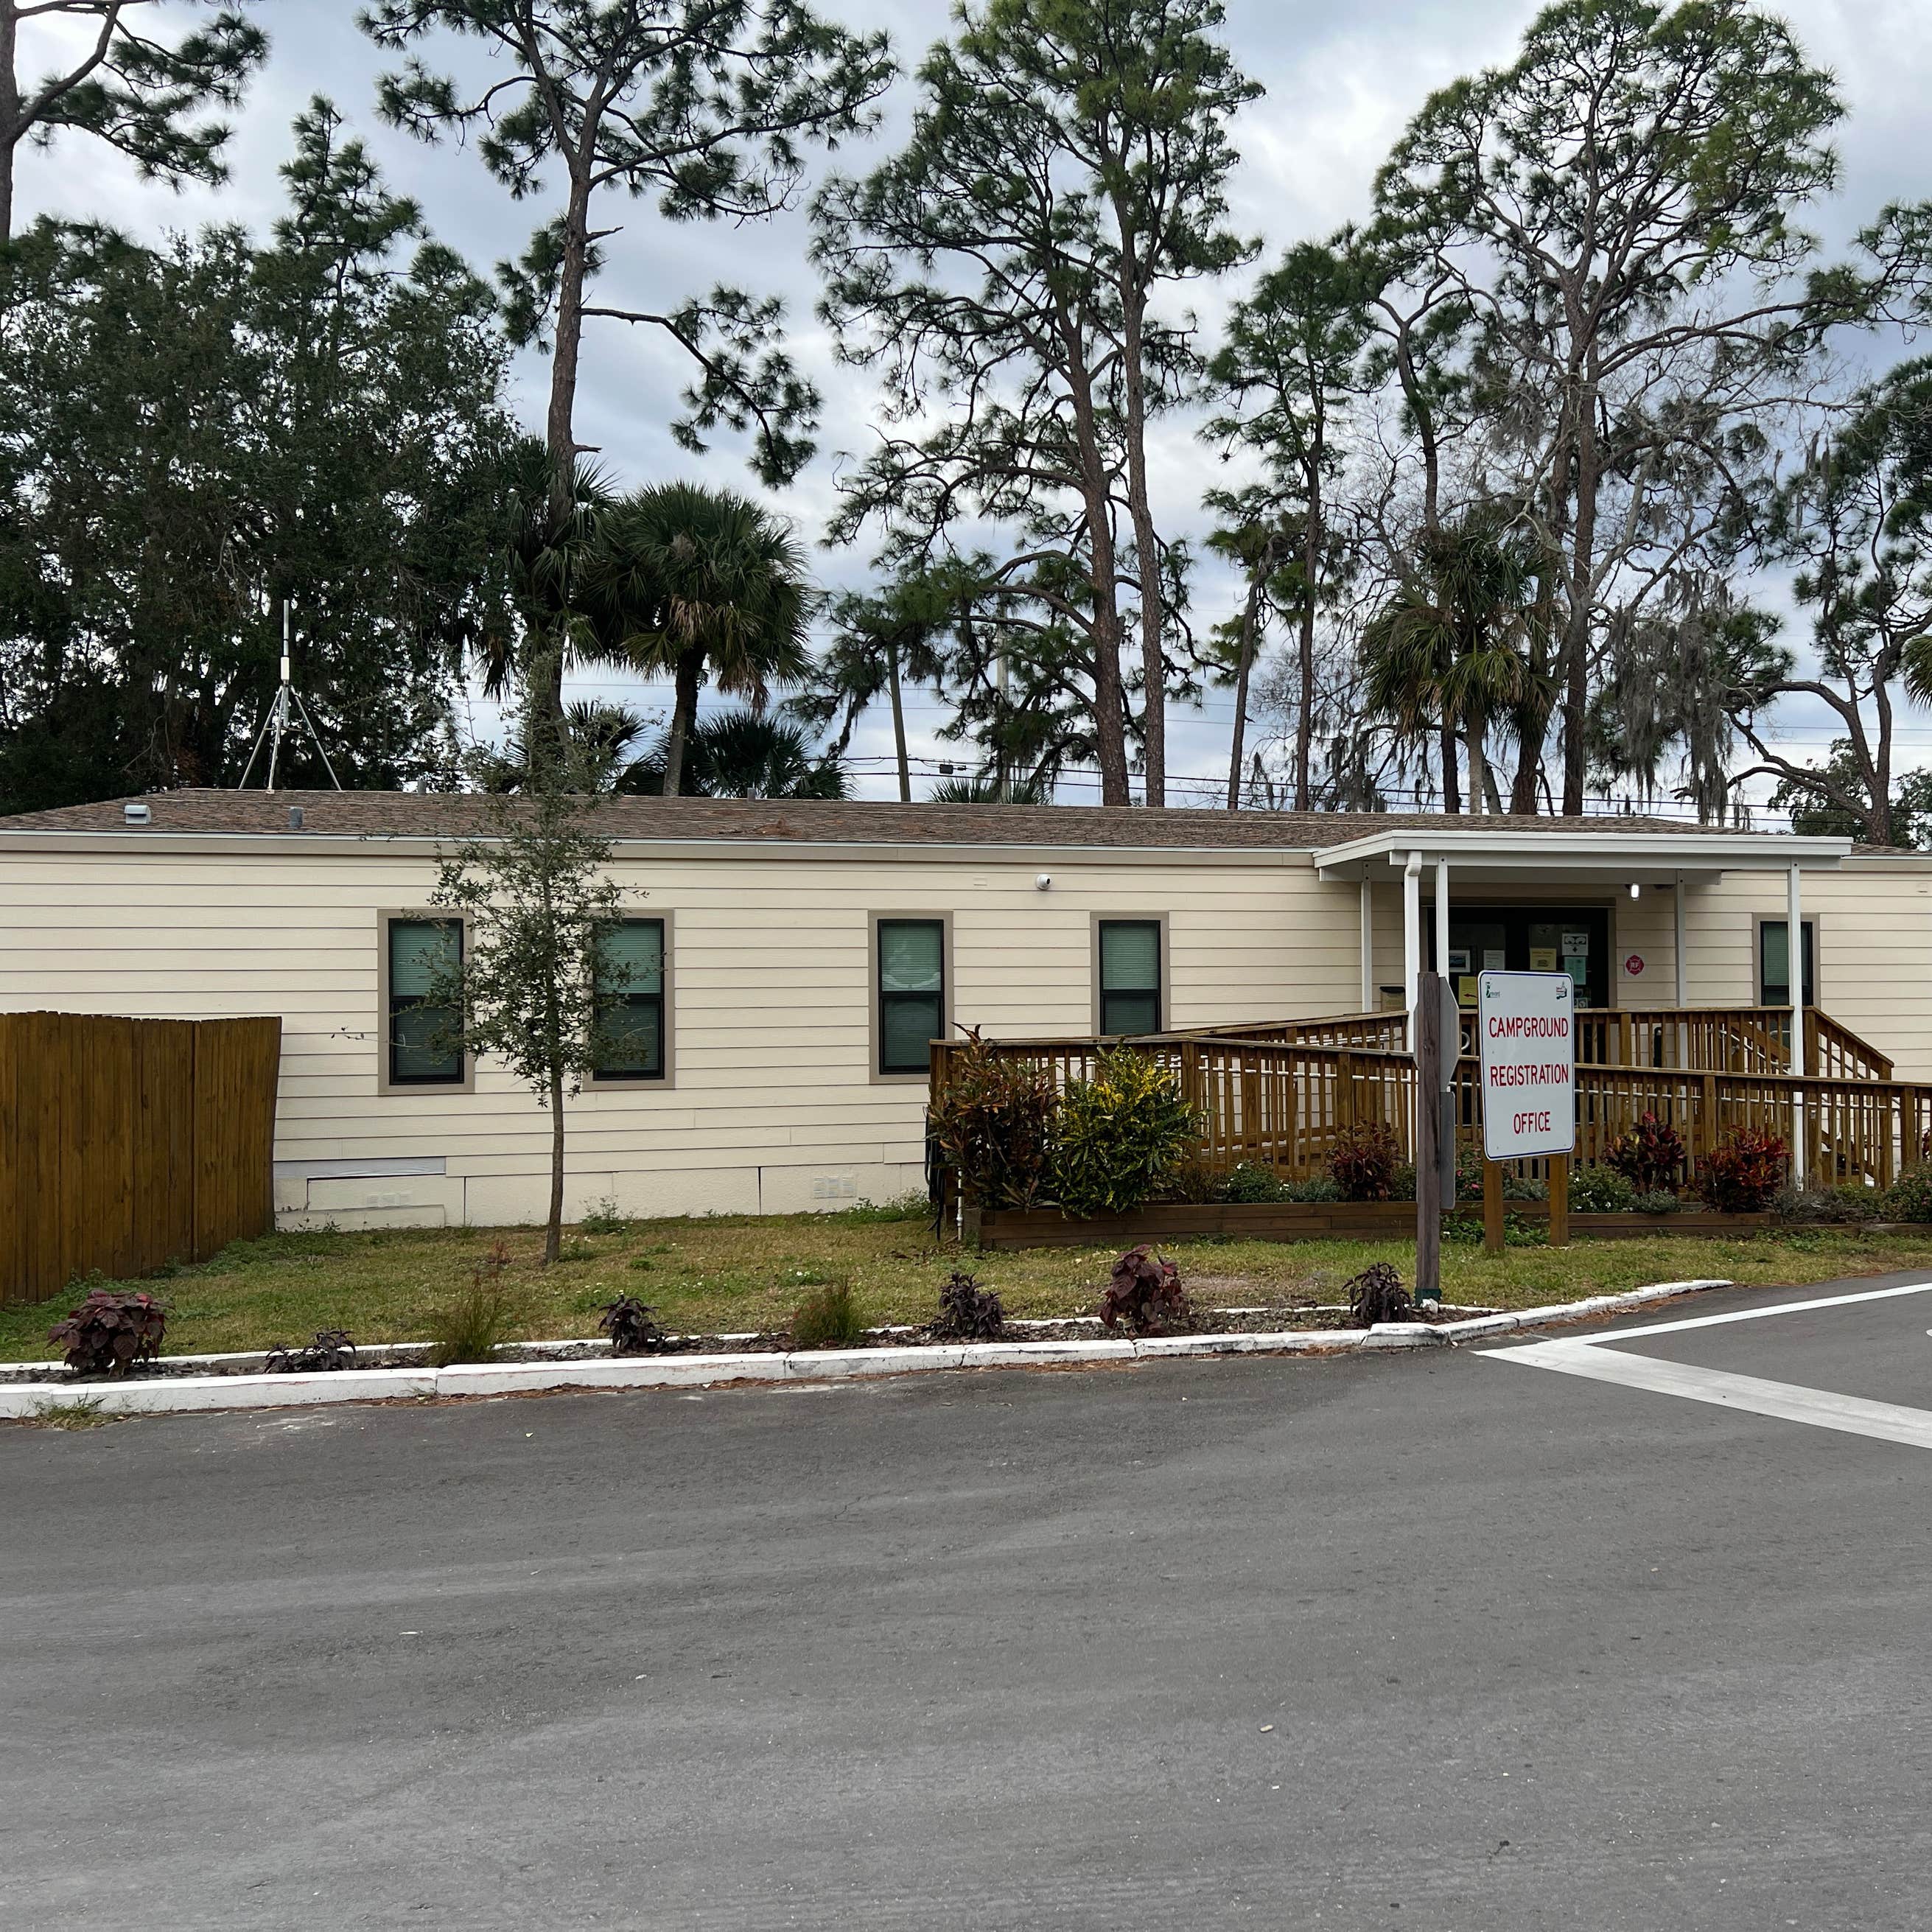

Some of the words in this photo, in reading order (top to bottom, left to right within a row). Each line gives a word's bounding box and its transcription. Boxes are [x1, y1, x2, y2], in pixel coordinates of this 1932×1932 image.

[1489, 1017, 1569, 1038] CAMPGROUND
[1490, 1063, 1569, 1087] REGISTRATION
[1513, 1111, 1551, 1135] OFFICE
